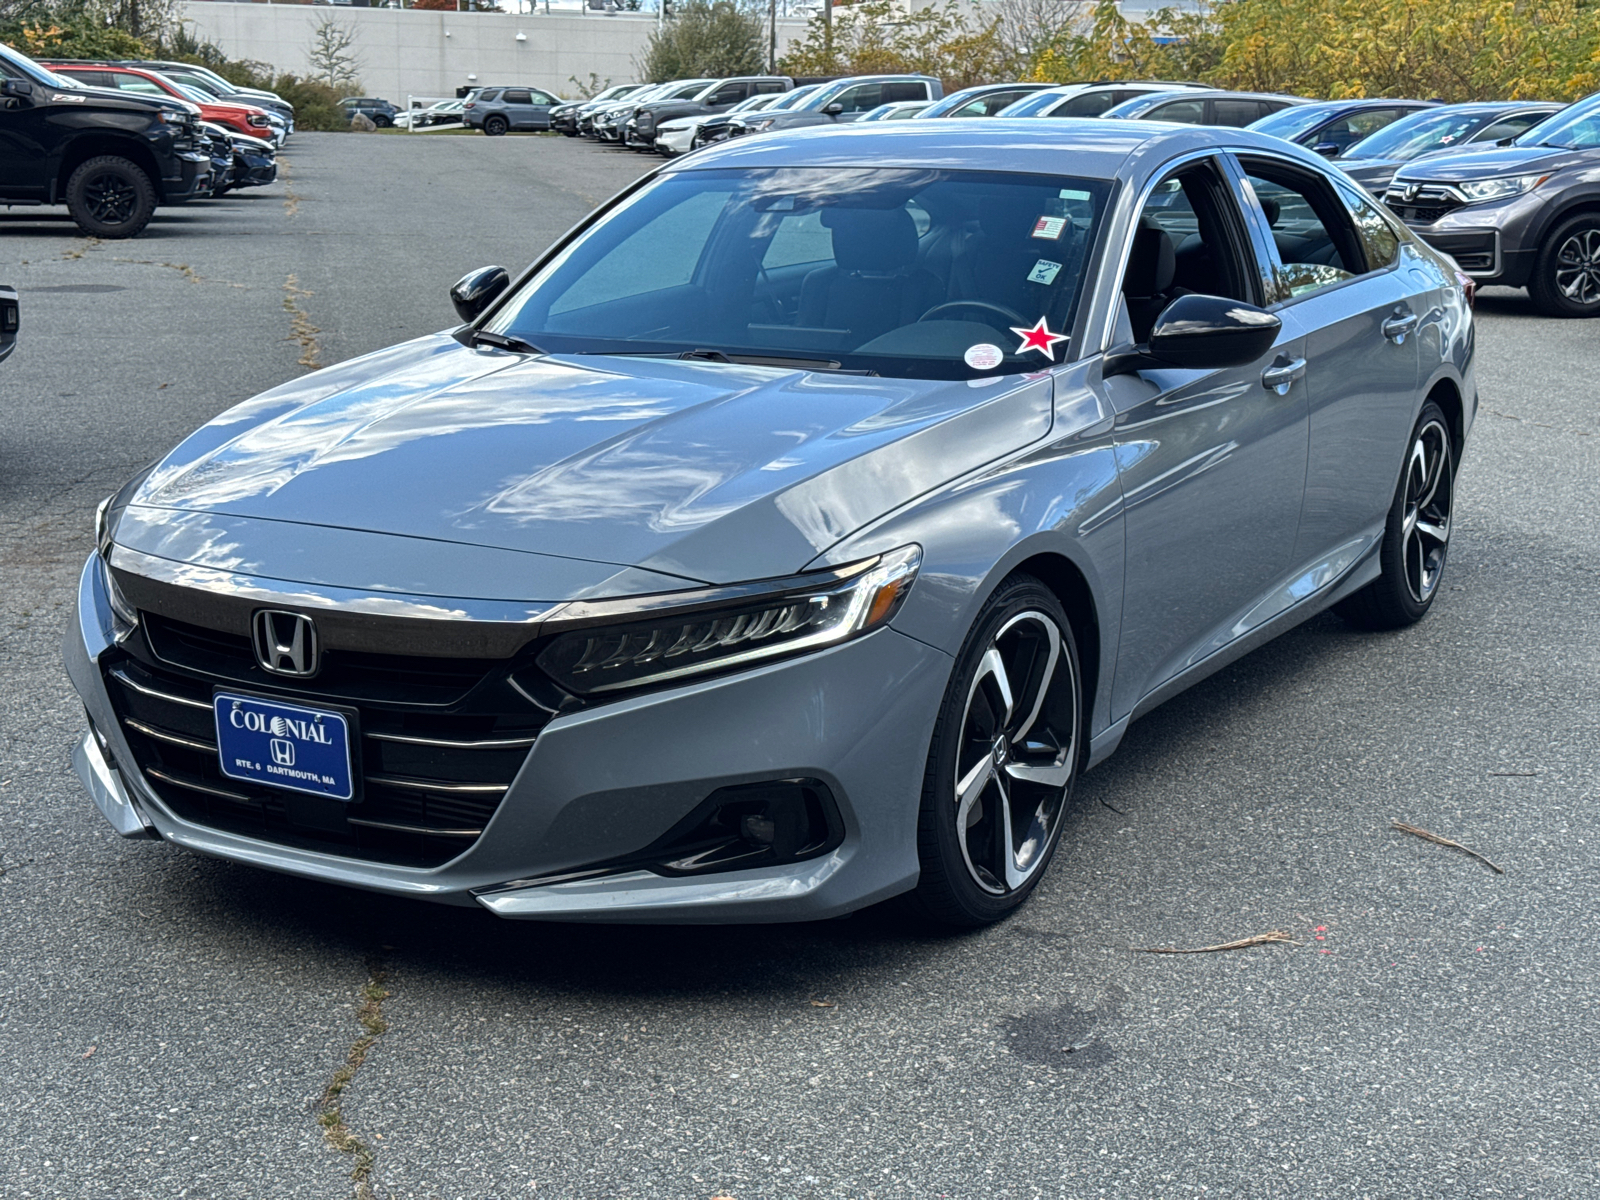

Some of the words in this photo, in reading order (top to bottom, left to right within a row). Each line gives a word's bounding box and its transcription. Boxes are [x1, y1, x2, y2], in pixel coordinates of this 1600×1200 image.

[1038, 260, 1060, 269] SAFETY
[230, 709, 332, 745] COLONIAL
[235, 758, 254, 770] RTE.
[255, 763, 261, 771] 6
[267, 764, 321, 784] DARTMOUTH,
[322, 775, 336, 785] MA
